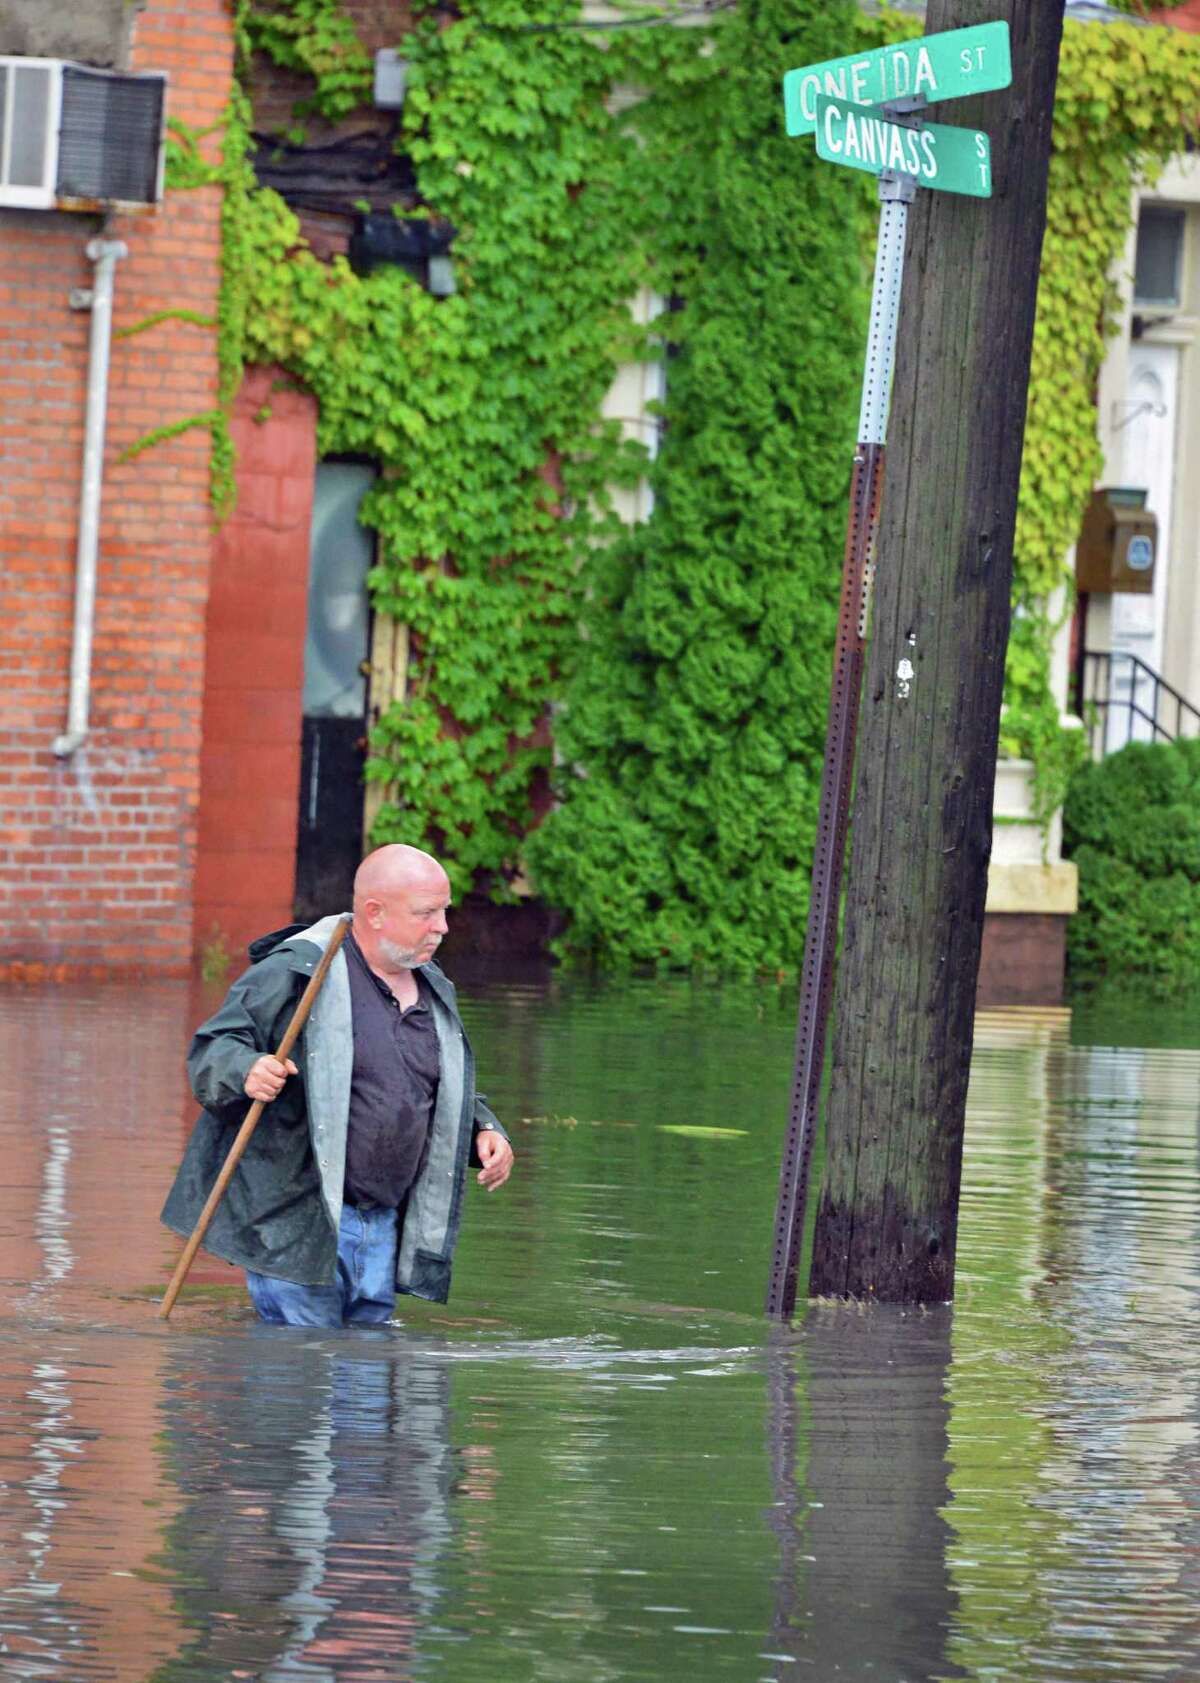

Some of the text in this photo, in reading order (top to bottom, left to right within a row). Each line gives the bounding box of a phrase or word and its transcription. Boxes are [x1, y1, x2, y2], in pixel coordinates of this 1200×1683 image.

[800, 47, 986, 121] ONEIDA ST
[825, 105, 937, 178] CANVASS
